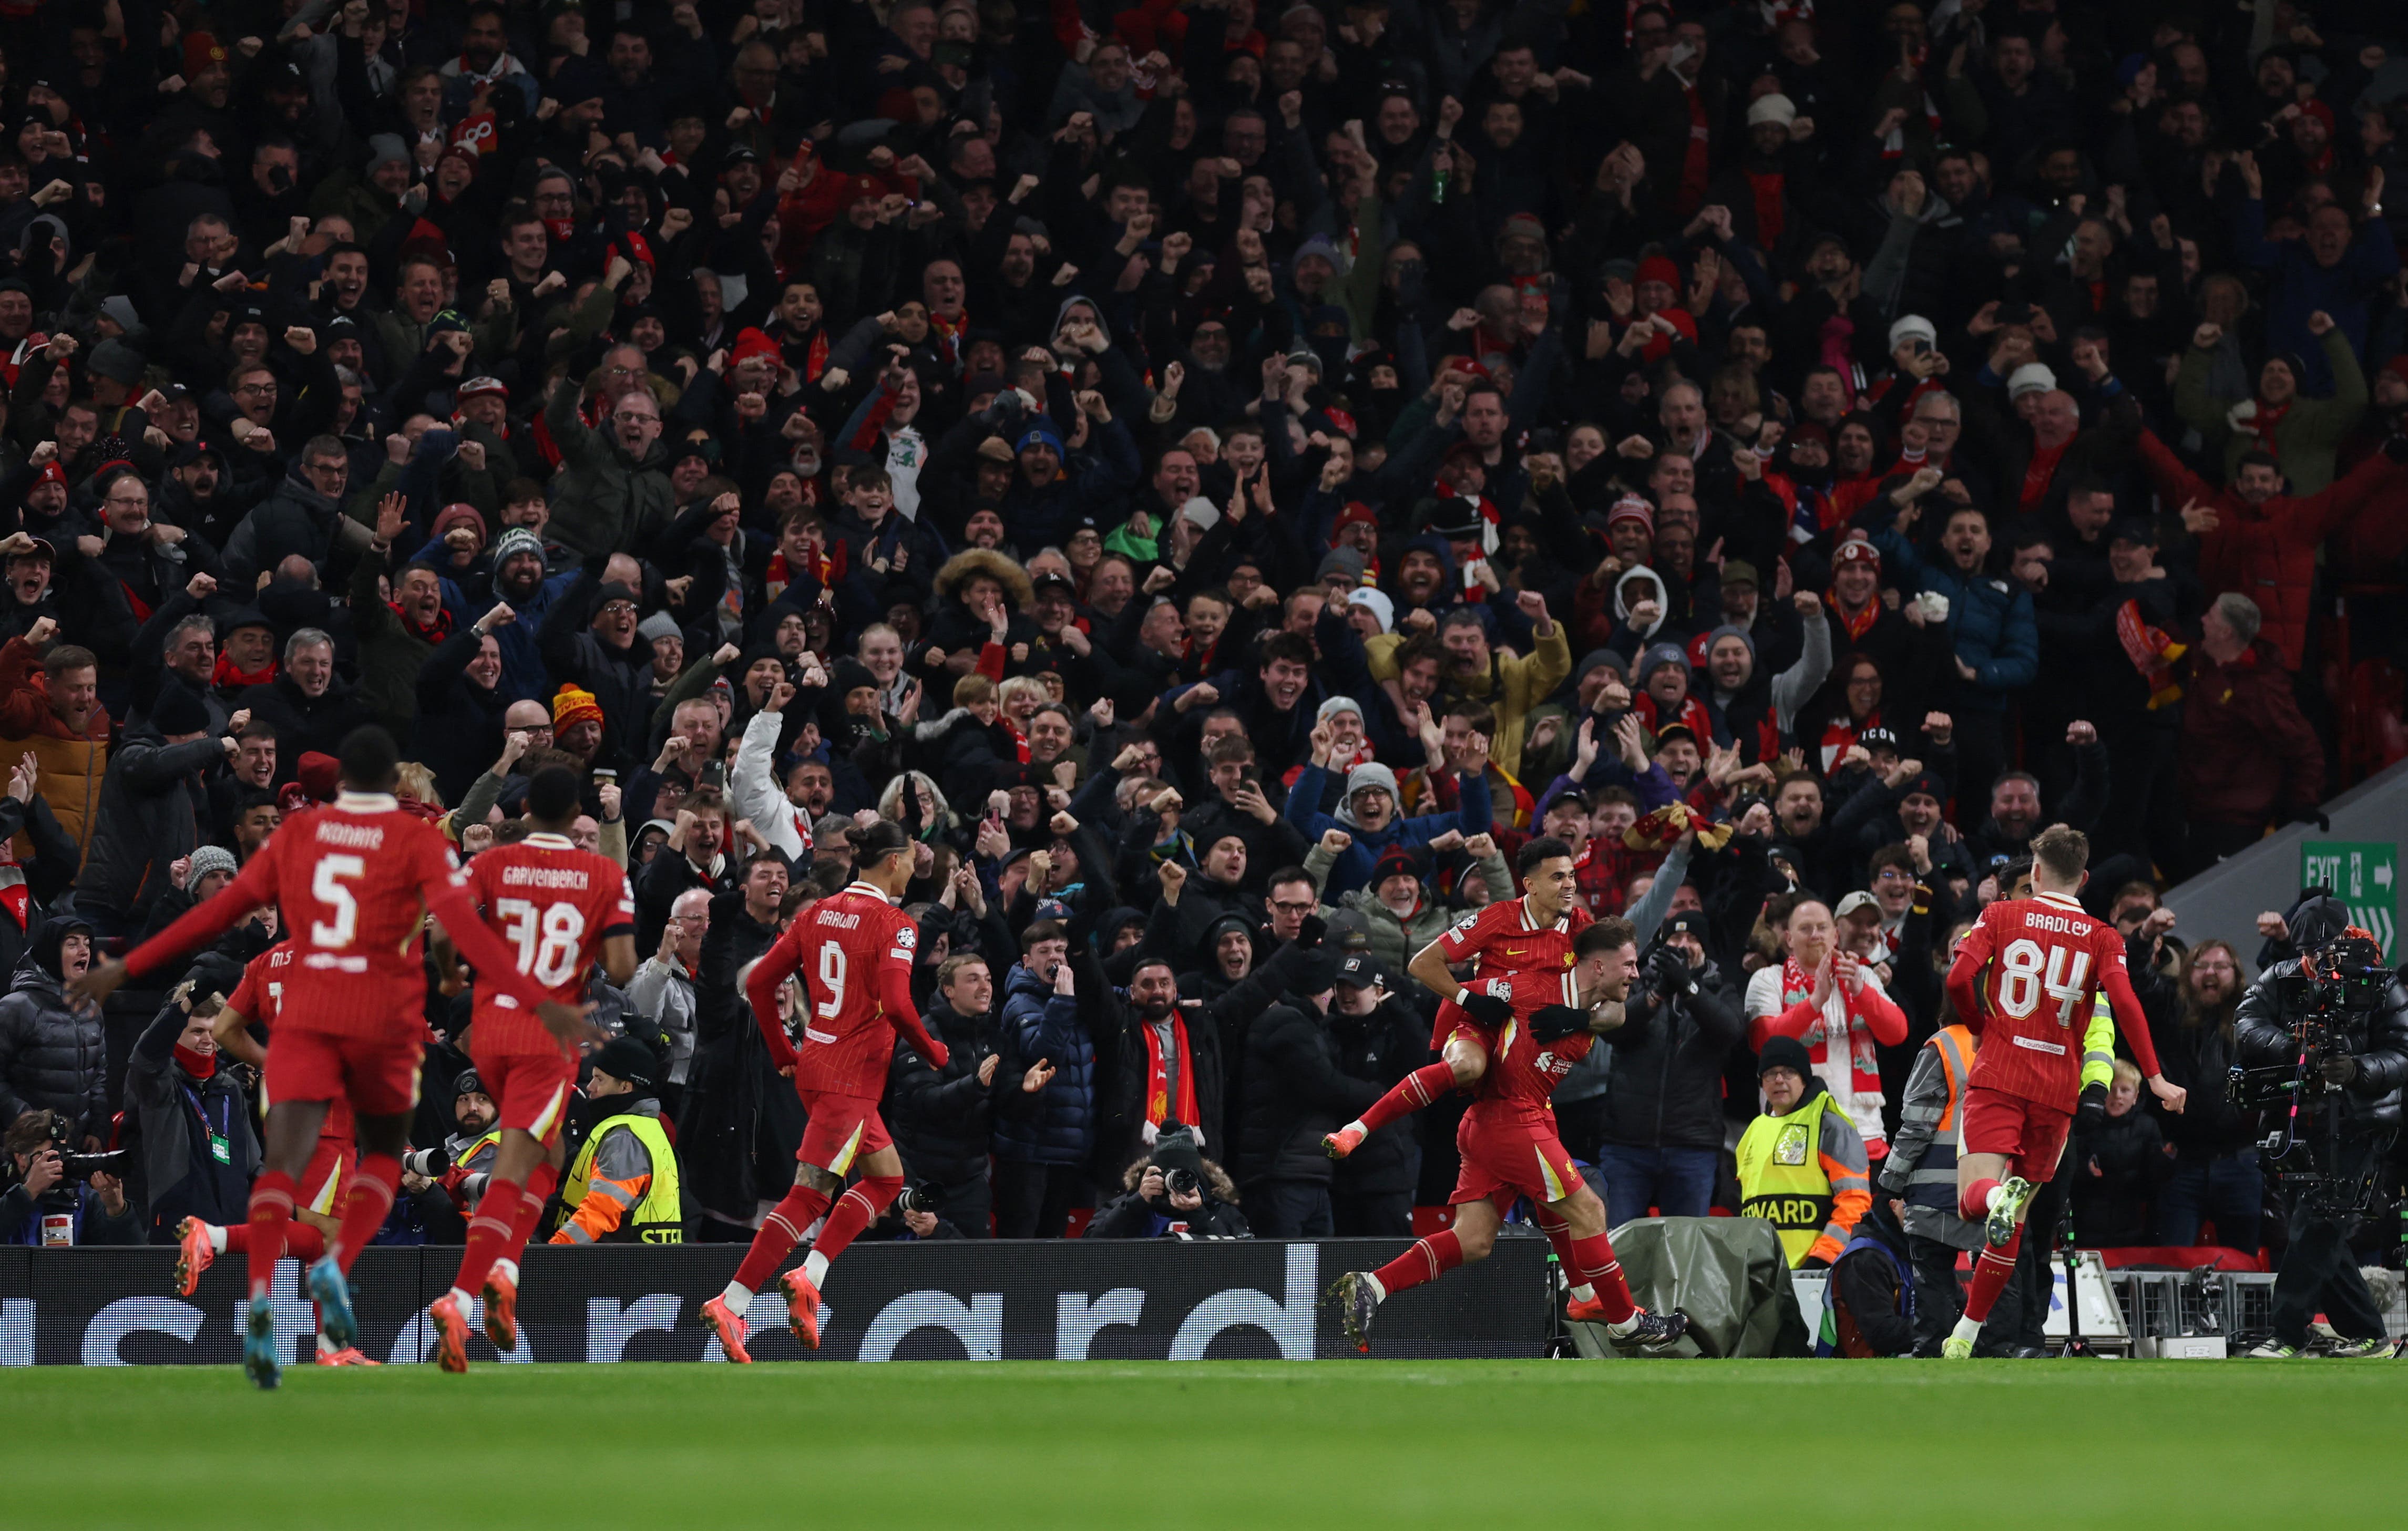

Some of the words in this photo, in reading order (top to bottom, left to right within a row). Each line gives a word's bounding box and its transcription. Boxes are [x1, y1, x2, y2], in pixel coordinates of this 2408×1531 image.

[1862, 727, 1896, 743] ICON
[2307, 856, 2340, 892] EXIT
[311, 852, 365, 948] 5
[817, 910, 860, 930] DARWIN
[2025, 912, 2092, 938] BRADLEY
[818, 940, 847, 1019] 9
[1999, 937, 2092, 1029] 84
[2022, 1039, 2063, 1054] Foundation
